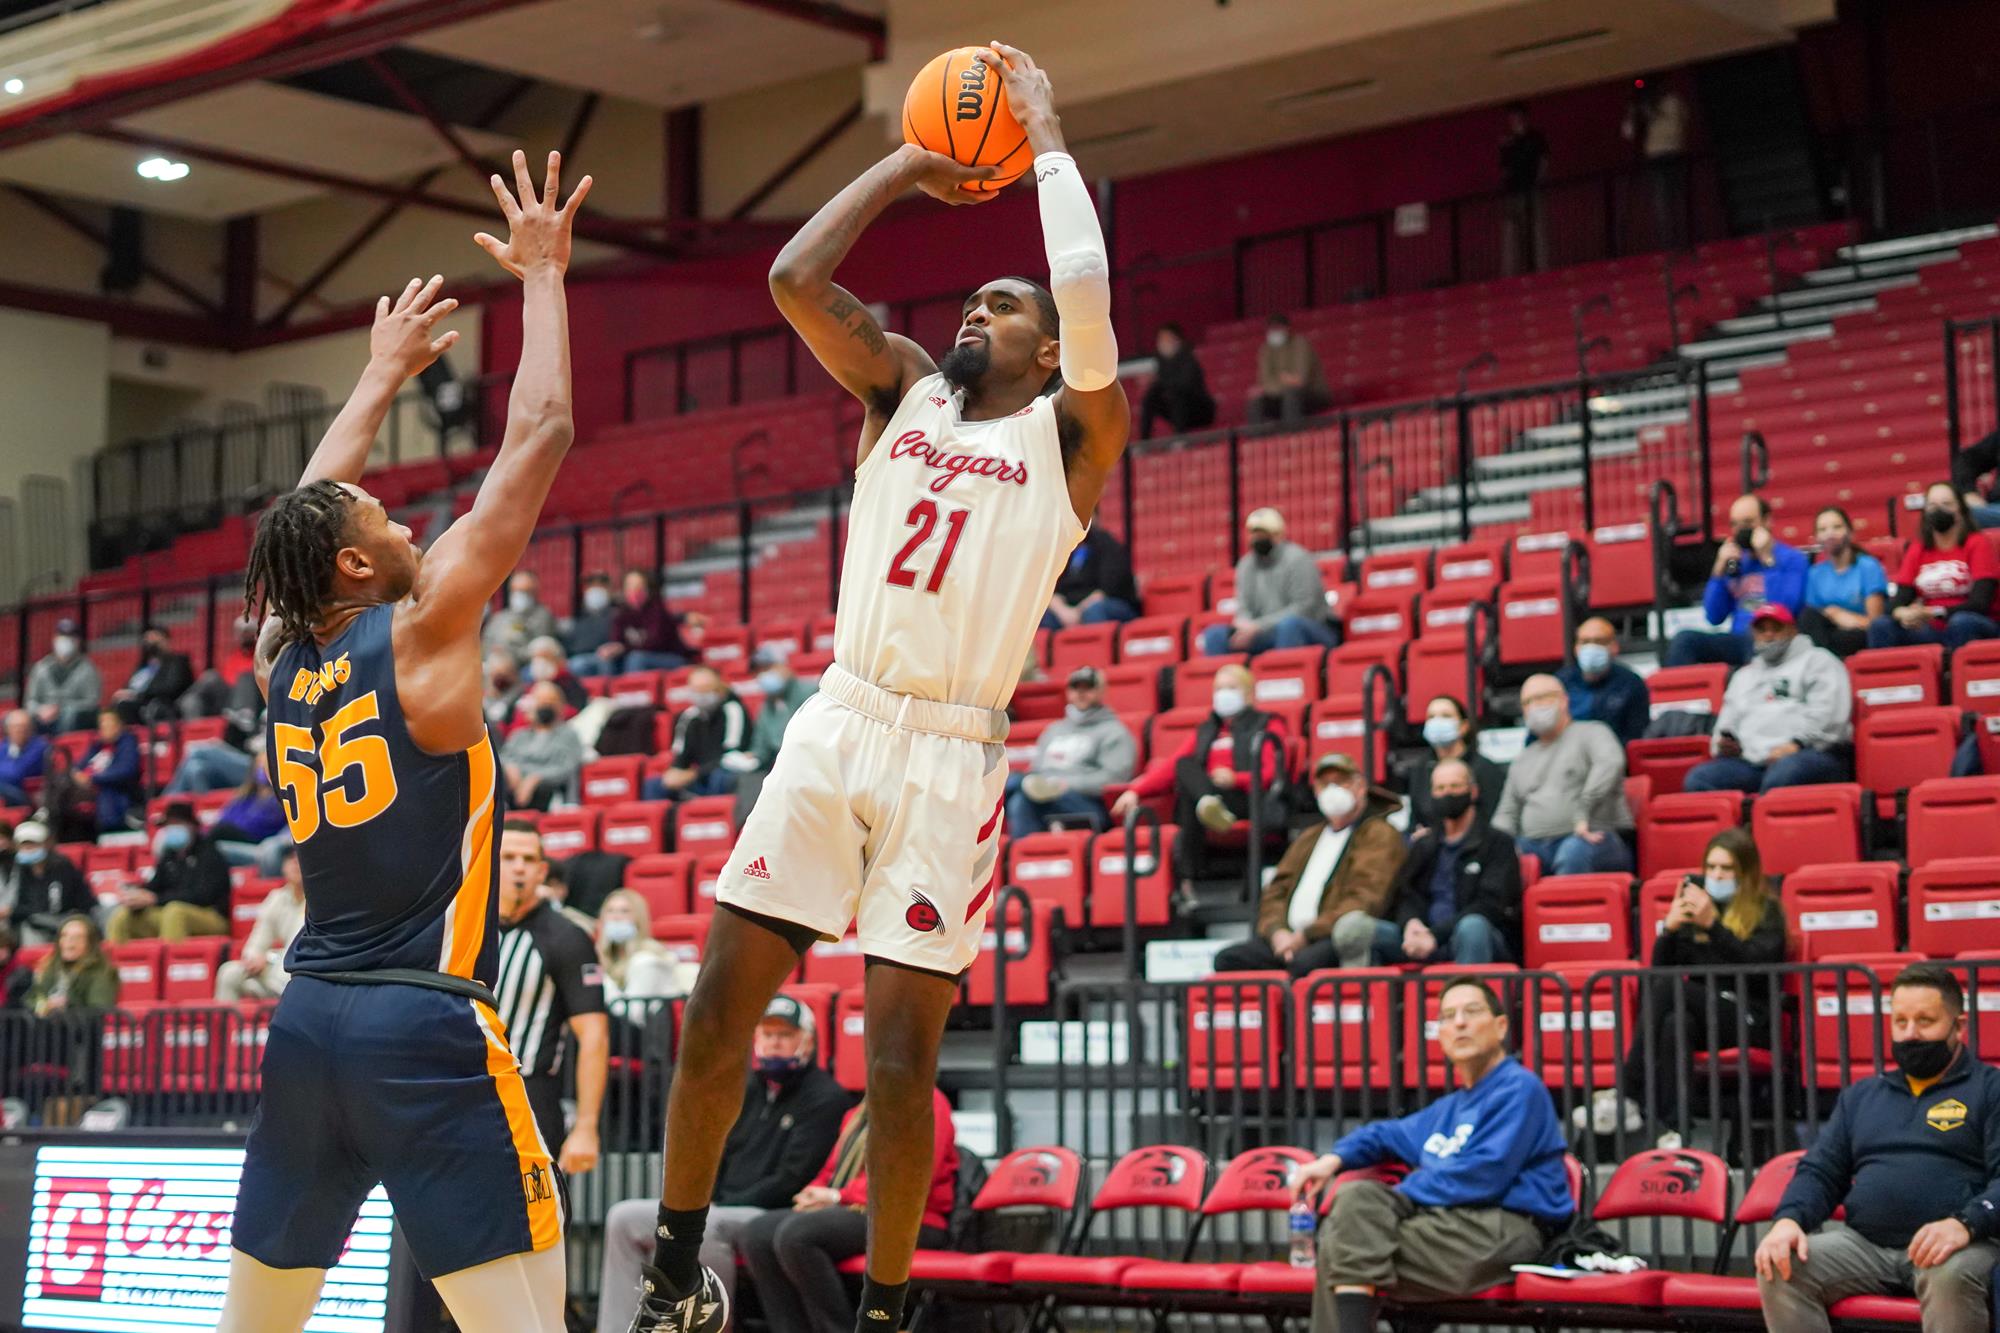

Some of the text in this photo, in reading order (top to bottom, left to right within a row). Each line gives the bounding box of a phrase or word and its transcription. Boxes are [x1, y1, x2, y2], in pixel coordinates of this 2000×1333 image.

[955, 54, 988, 122] Wils
[889, 429, 1028, 493] Cougars
[886, 497, 972, 595] 21
[274, 690, 398, 844] 55
[743, 867, 771, 880] adidas
